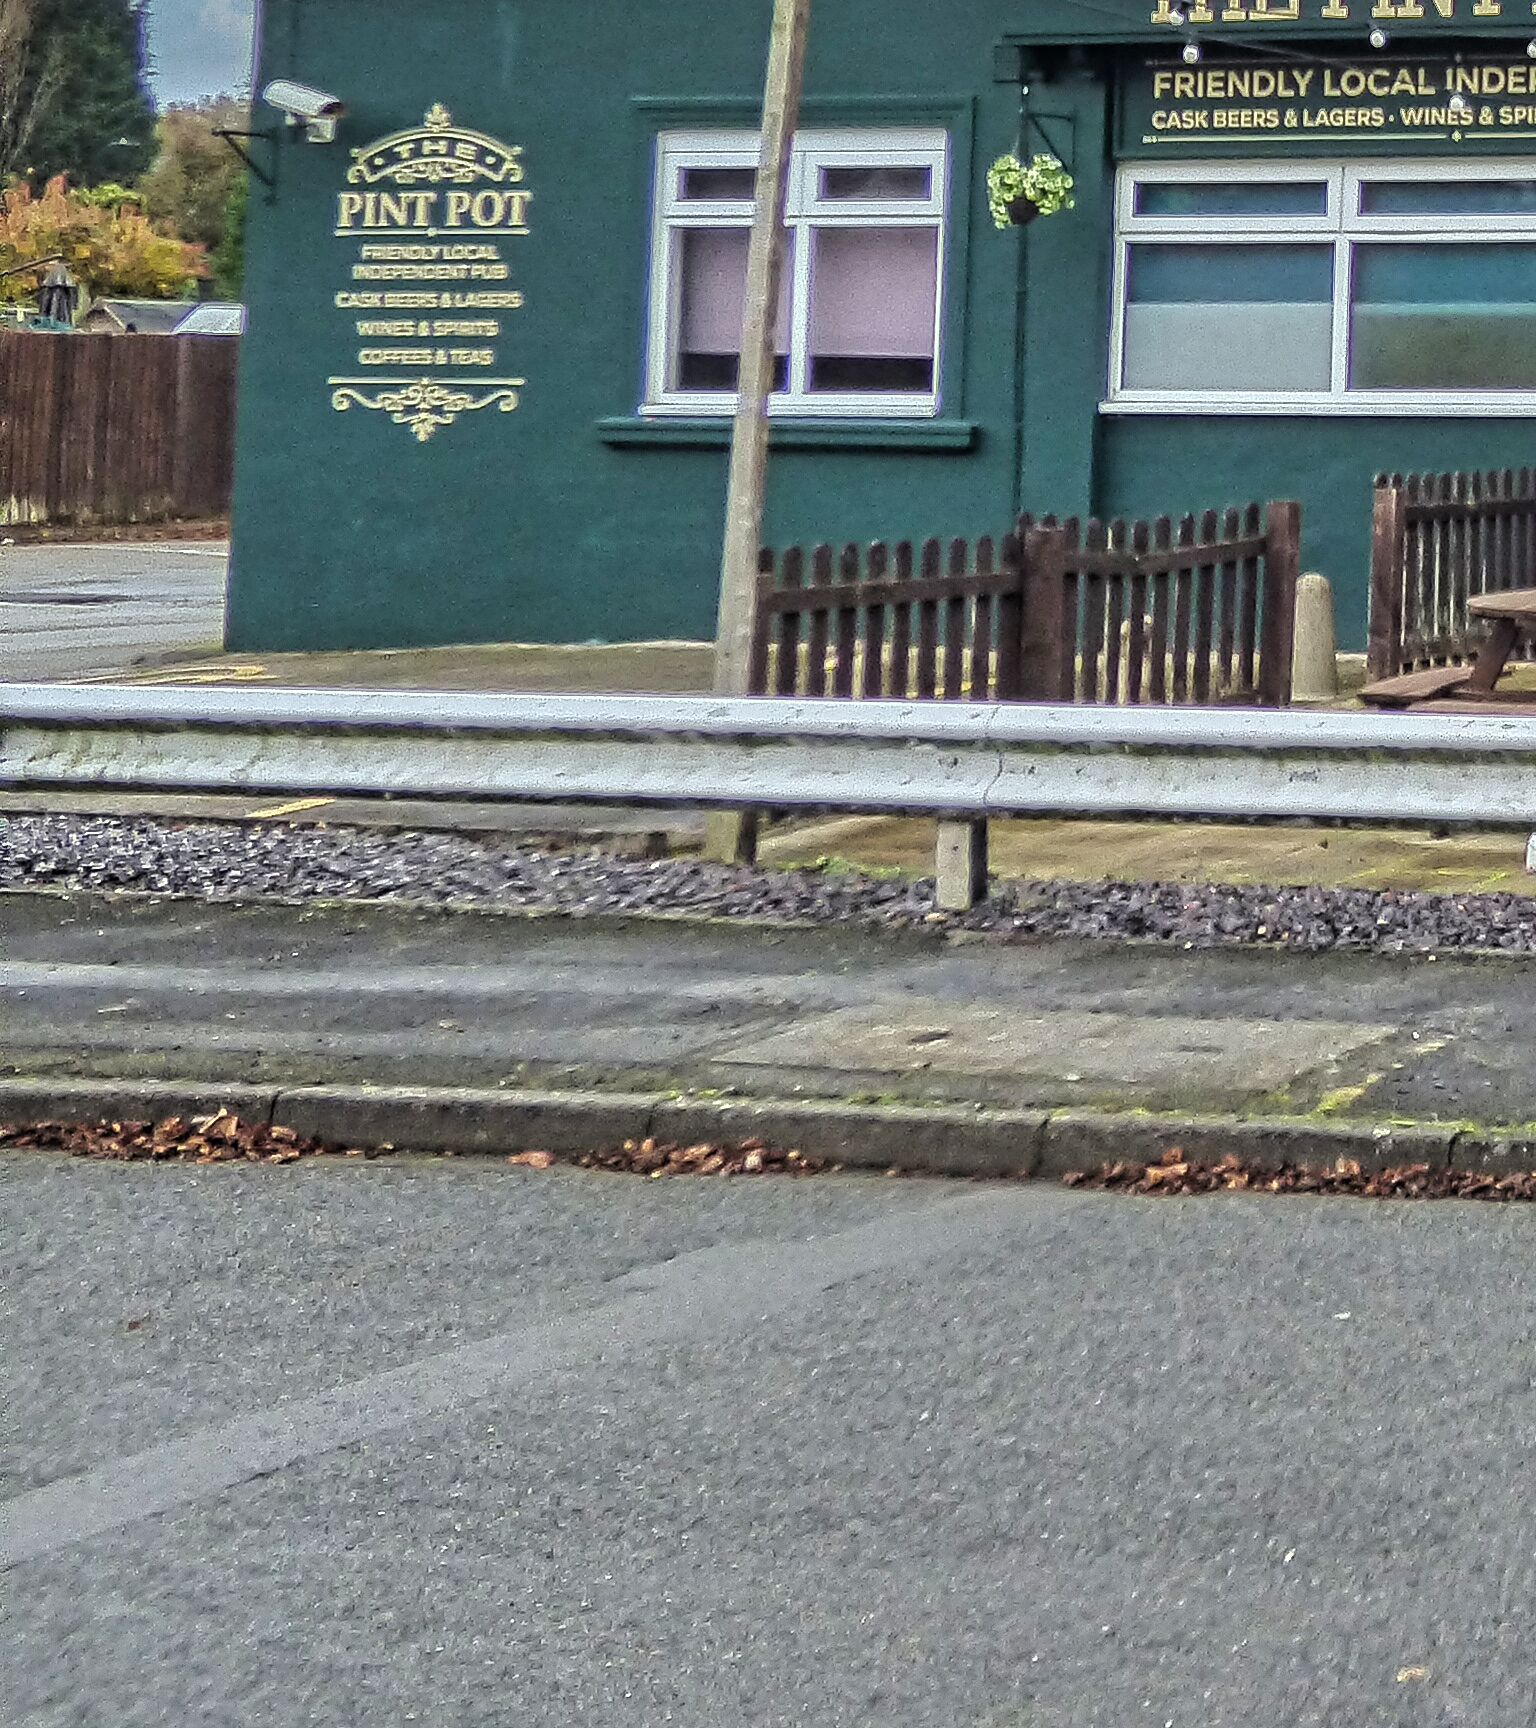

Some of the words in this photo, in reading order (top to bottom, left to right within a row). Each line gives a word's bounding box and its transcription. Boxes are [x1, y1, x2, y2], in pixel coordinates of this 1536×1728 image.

[1153, 69, 1314, 98] FRIENDLY
[1323, 67, 1436, 97] LOCAL
[1151, 109, 1209, 130] CASK
[1213, 109, 1279, 129] BEERS
[1283, 108, 1299, 128] &
[1303, 106, 1385, 127] LAGERS
[1400, 105, 1473, 126] WINES
[1478, 106, 1494, 125] &
[393, 140, 478, 160] THE
[337, 191, 437, 227] PINT
[445, 190, 533, 227] POT
[362, 245, 439, 260] FRIENDLY
[443, 244, 500, 260] LOCAL
[352, 264, 470, 280] INDEPENDENT
[471, 264, 509, 280] PUB
[335, 291, 381, 308] CASK
[449, 349, 494, 365] TEAS
